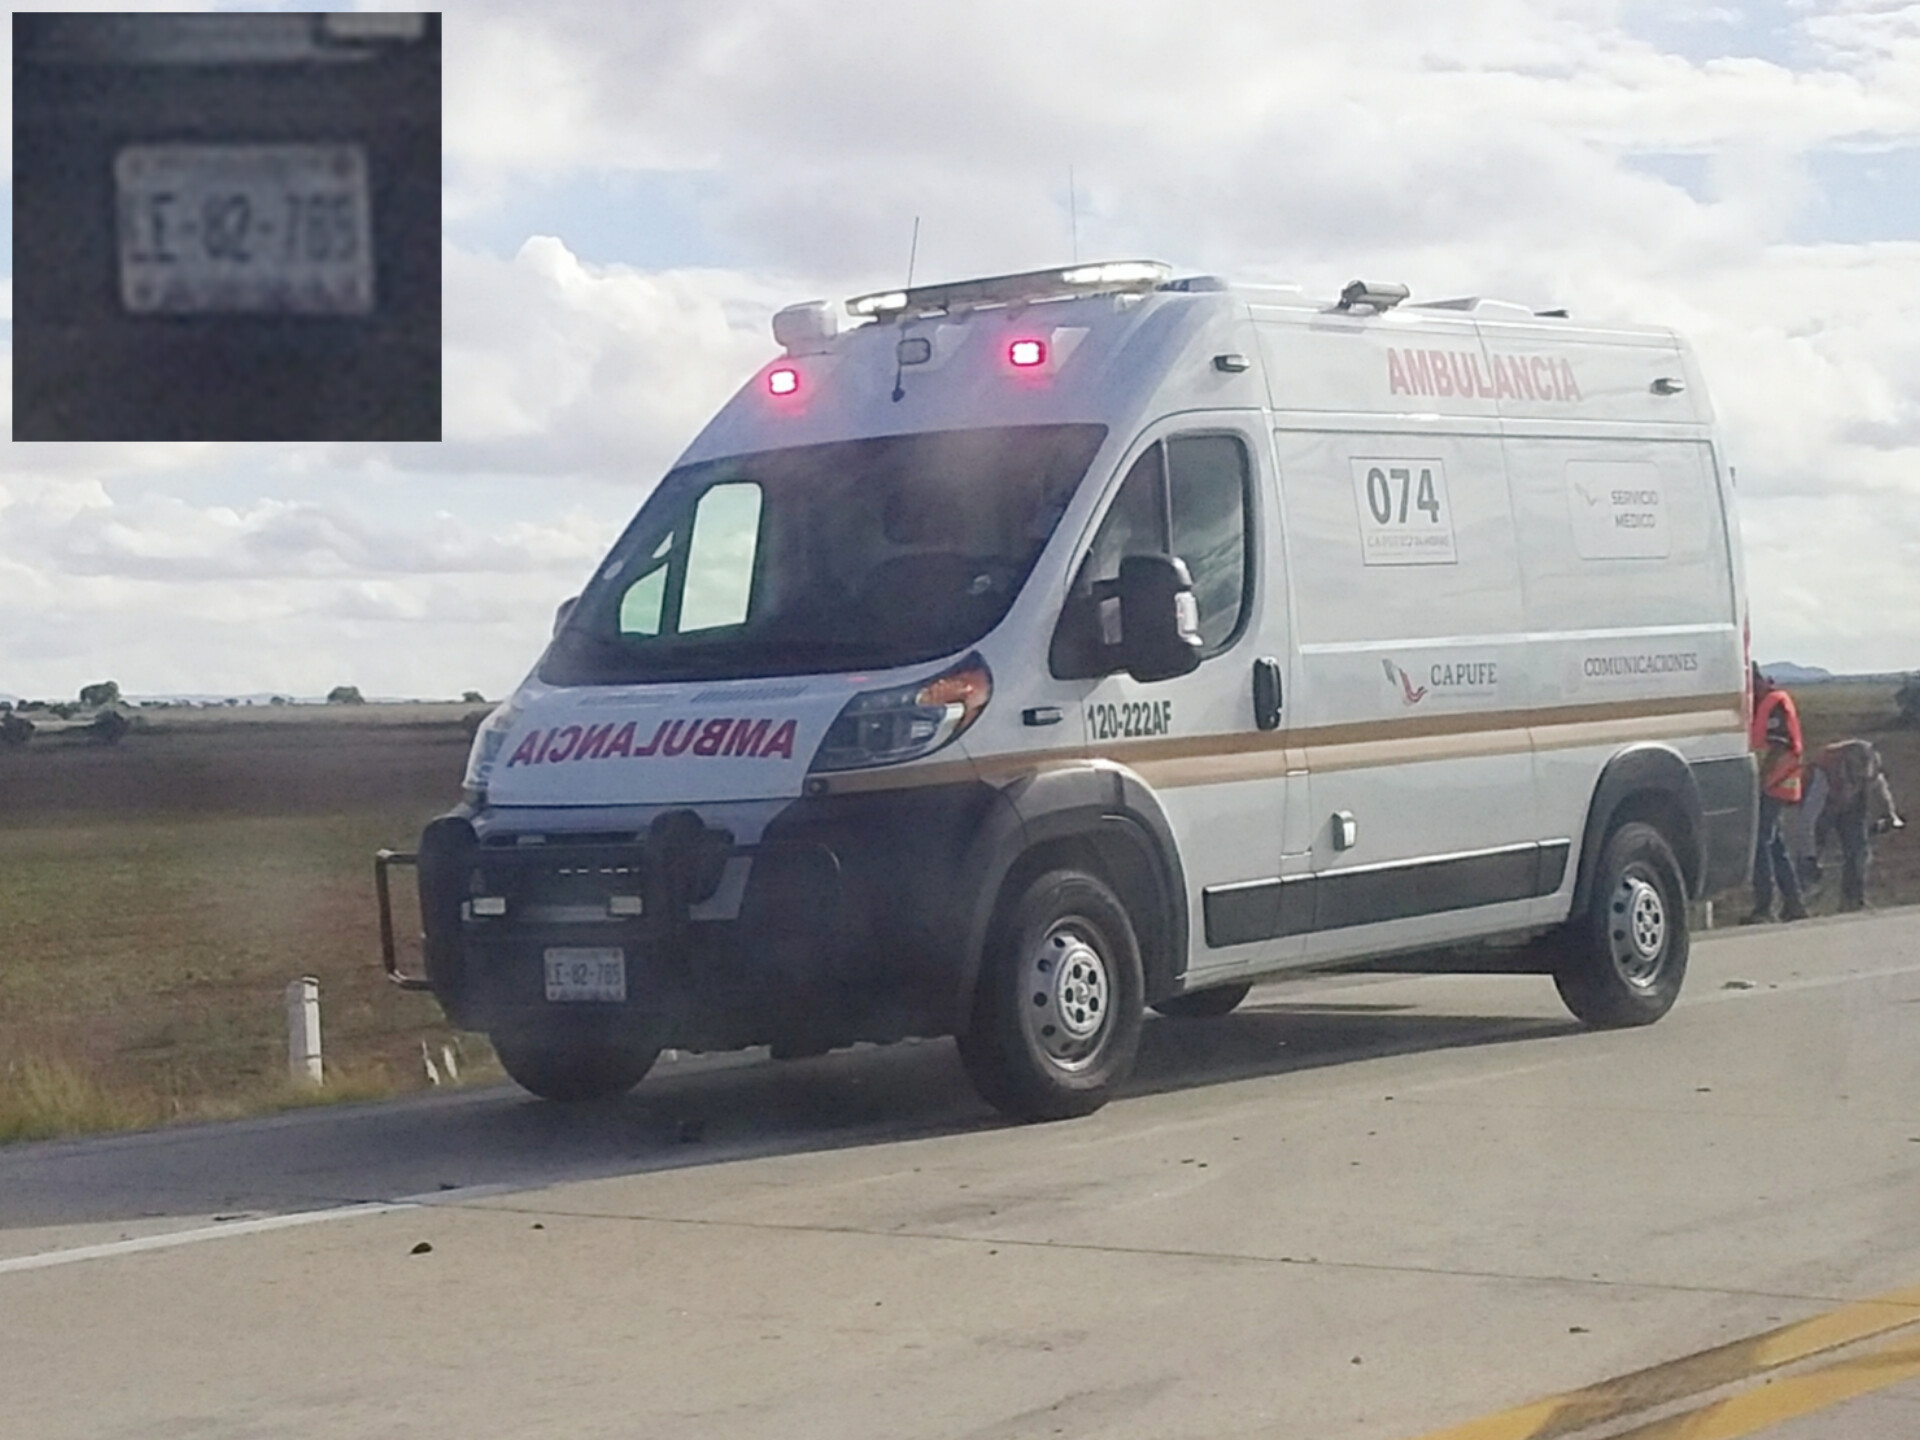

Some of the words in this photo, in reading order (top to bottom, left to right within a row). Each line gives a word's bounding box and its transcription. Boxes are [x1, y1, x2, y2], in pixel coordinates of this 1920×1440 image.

[1386, 347, 1582, 401] AMBULANCIA
[1367, 467, 1440, 525] 074
[1611, 490, 1659, 506] SERVICIO
[1430, 662, 1497, 686] CAPUFE
[1583, 653, 1698, 677] COMUNICACIONES
[1087, 700, 1172, 740] 120-222AF
